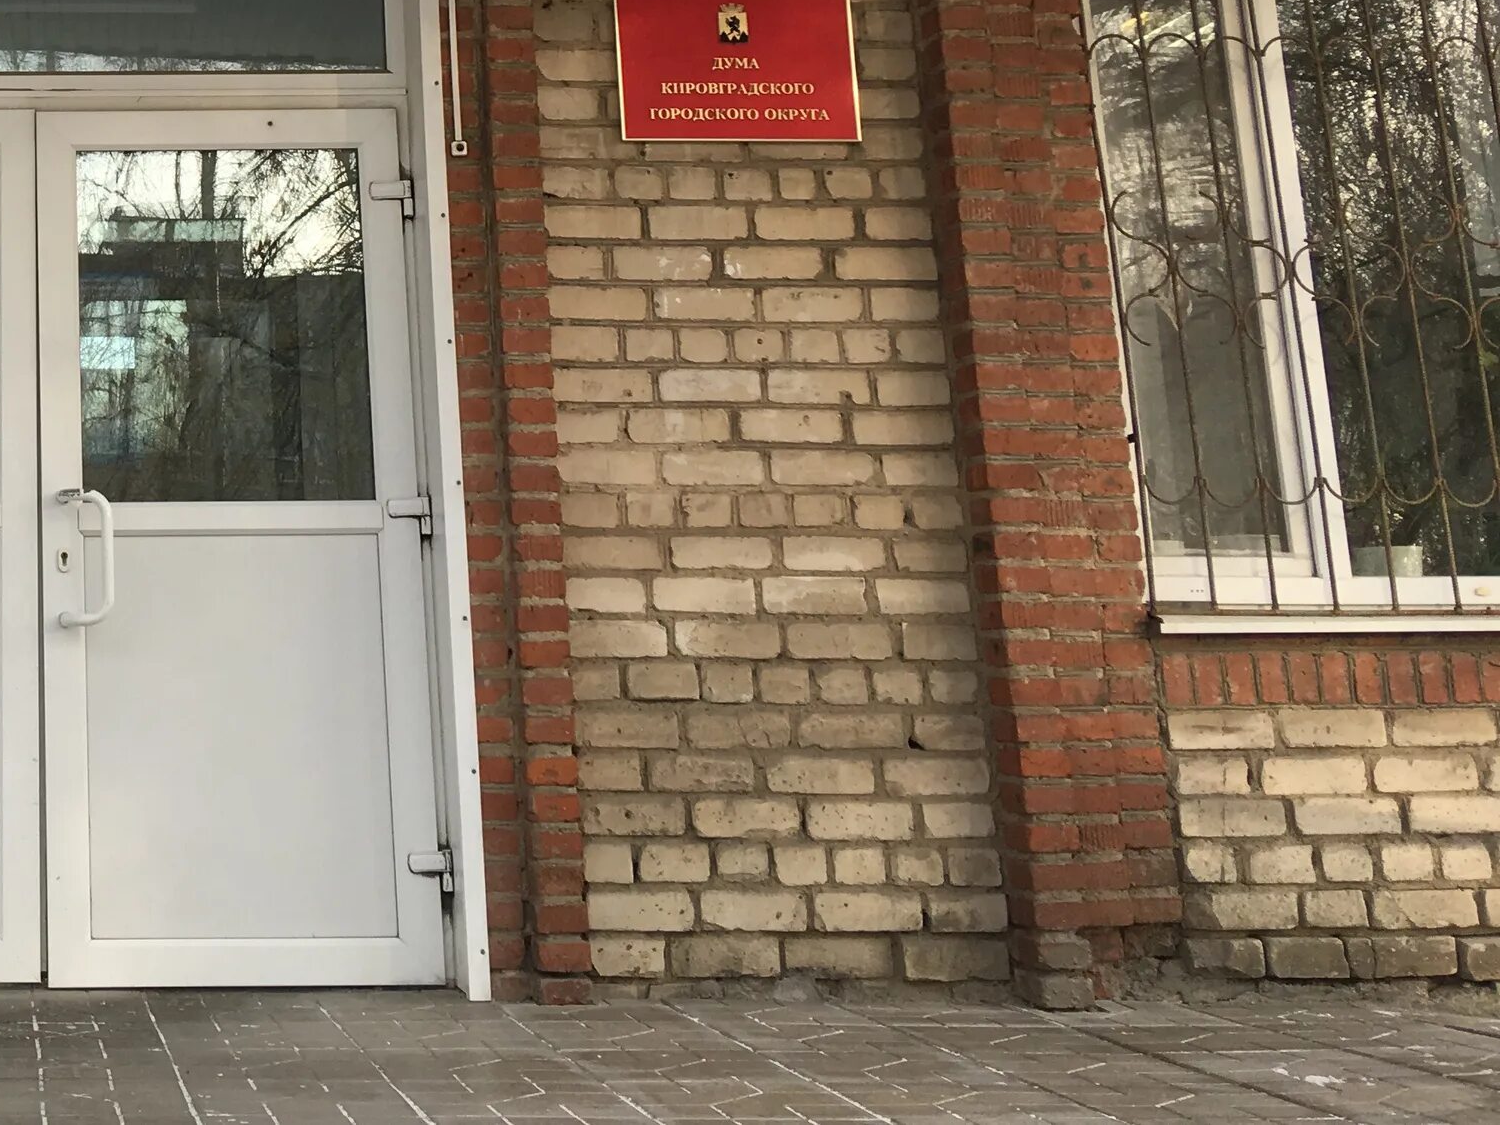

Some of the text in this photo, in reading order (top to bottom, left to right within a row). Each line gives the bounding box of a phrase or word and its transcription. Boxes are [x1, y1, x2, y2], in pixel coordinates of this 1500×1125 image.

[712, 57, 760, 70] ДУМА
[661, 82, 815, 97] КИРОВГРАДСКОГО
[650, 107, 830, 121] ГОРОДСКОГО ОКРУГА
